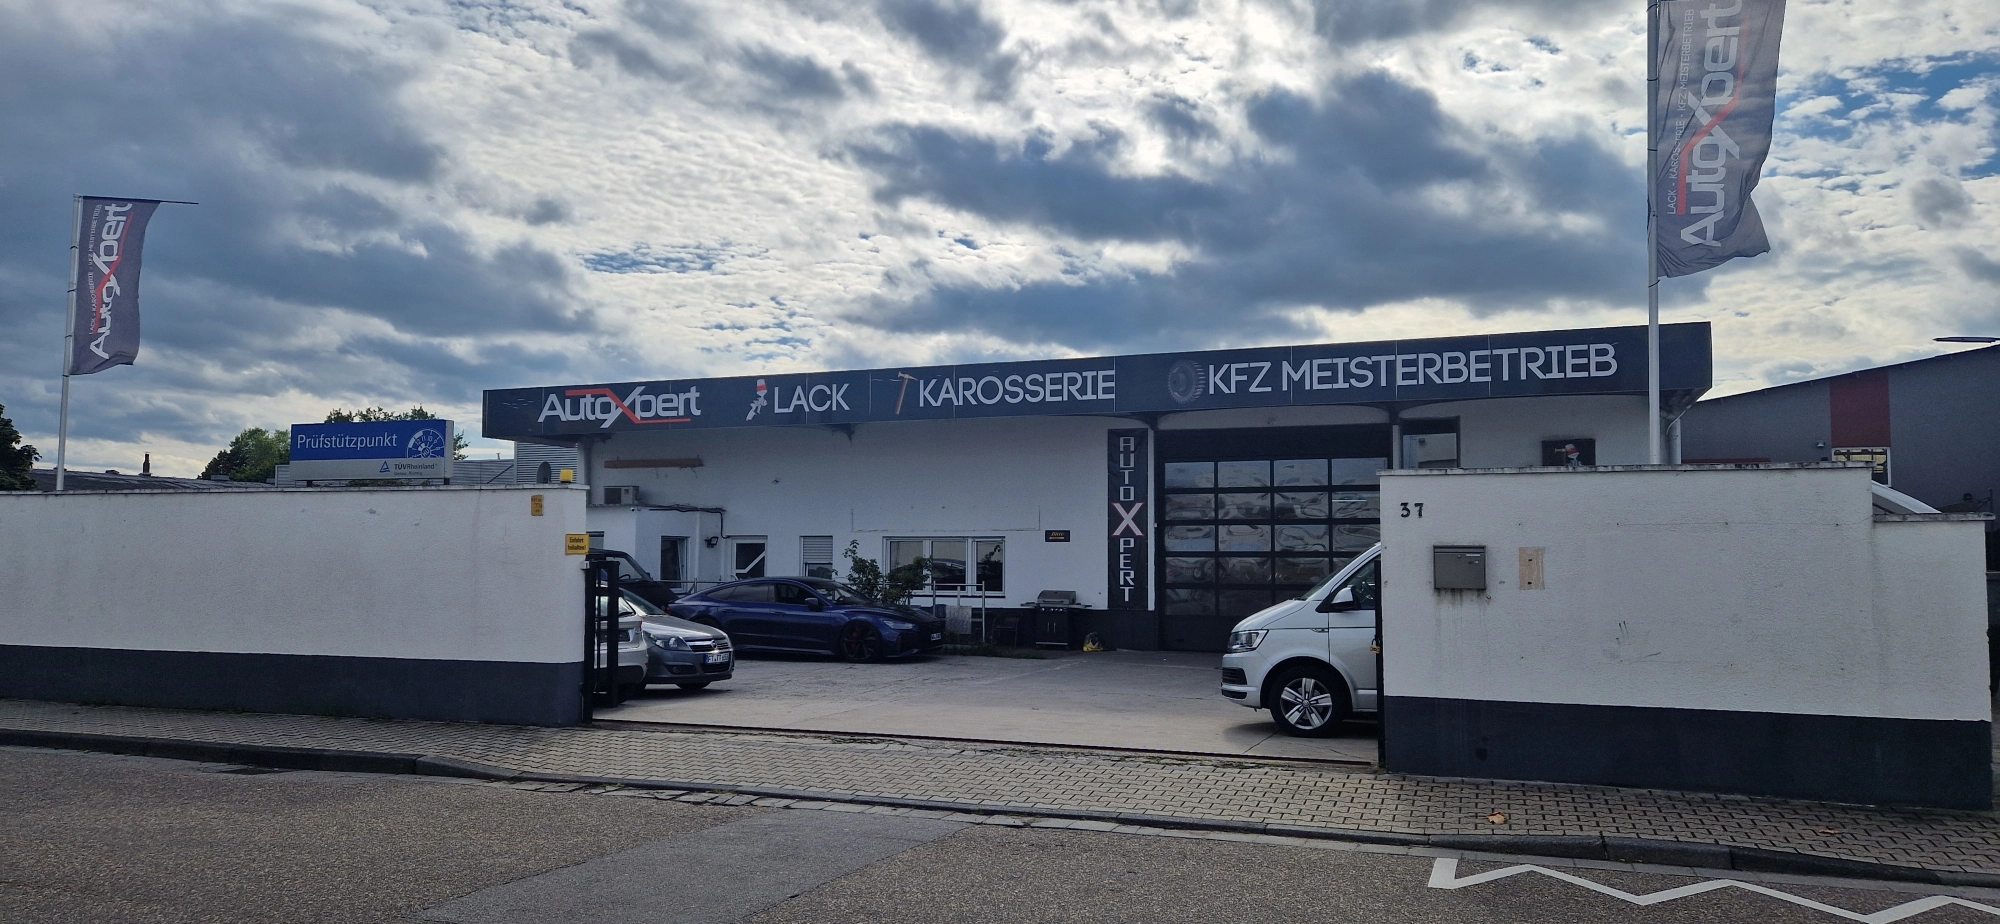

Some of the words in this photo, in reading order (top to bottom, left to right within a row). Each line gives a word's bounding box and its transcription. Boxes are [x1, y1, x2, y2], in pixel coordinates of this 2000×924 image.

[1680, 8, 1695, 90] MEISTERBETRIEB
[1677, 93, 1687, 111] KFZ
[1681, 0, 1742, 247] AutoXpert
[1667, 188, 1677, 215] LACK
[90, 203, 133, 360] AutoXpert
[919, 369, 1116, 407] KAROSSERIE
[1208, 361, 1273, 395] KFZ
[1281, 343, 1619, 391] MEISTERBETRIEB
[537, 385, 701, 429] AutoXpert
[774, 383, 850, 414] LACK
[297, 431, 398, 451] Prüfstützpunkt
[1400, 502, 1424, 518] 37
